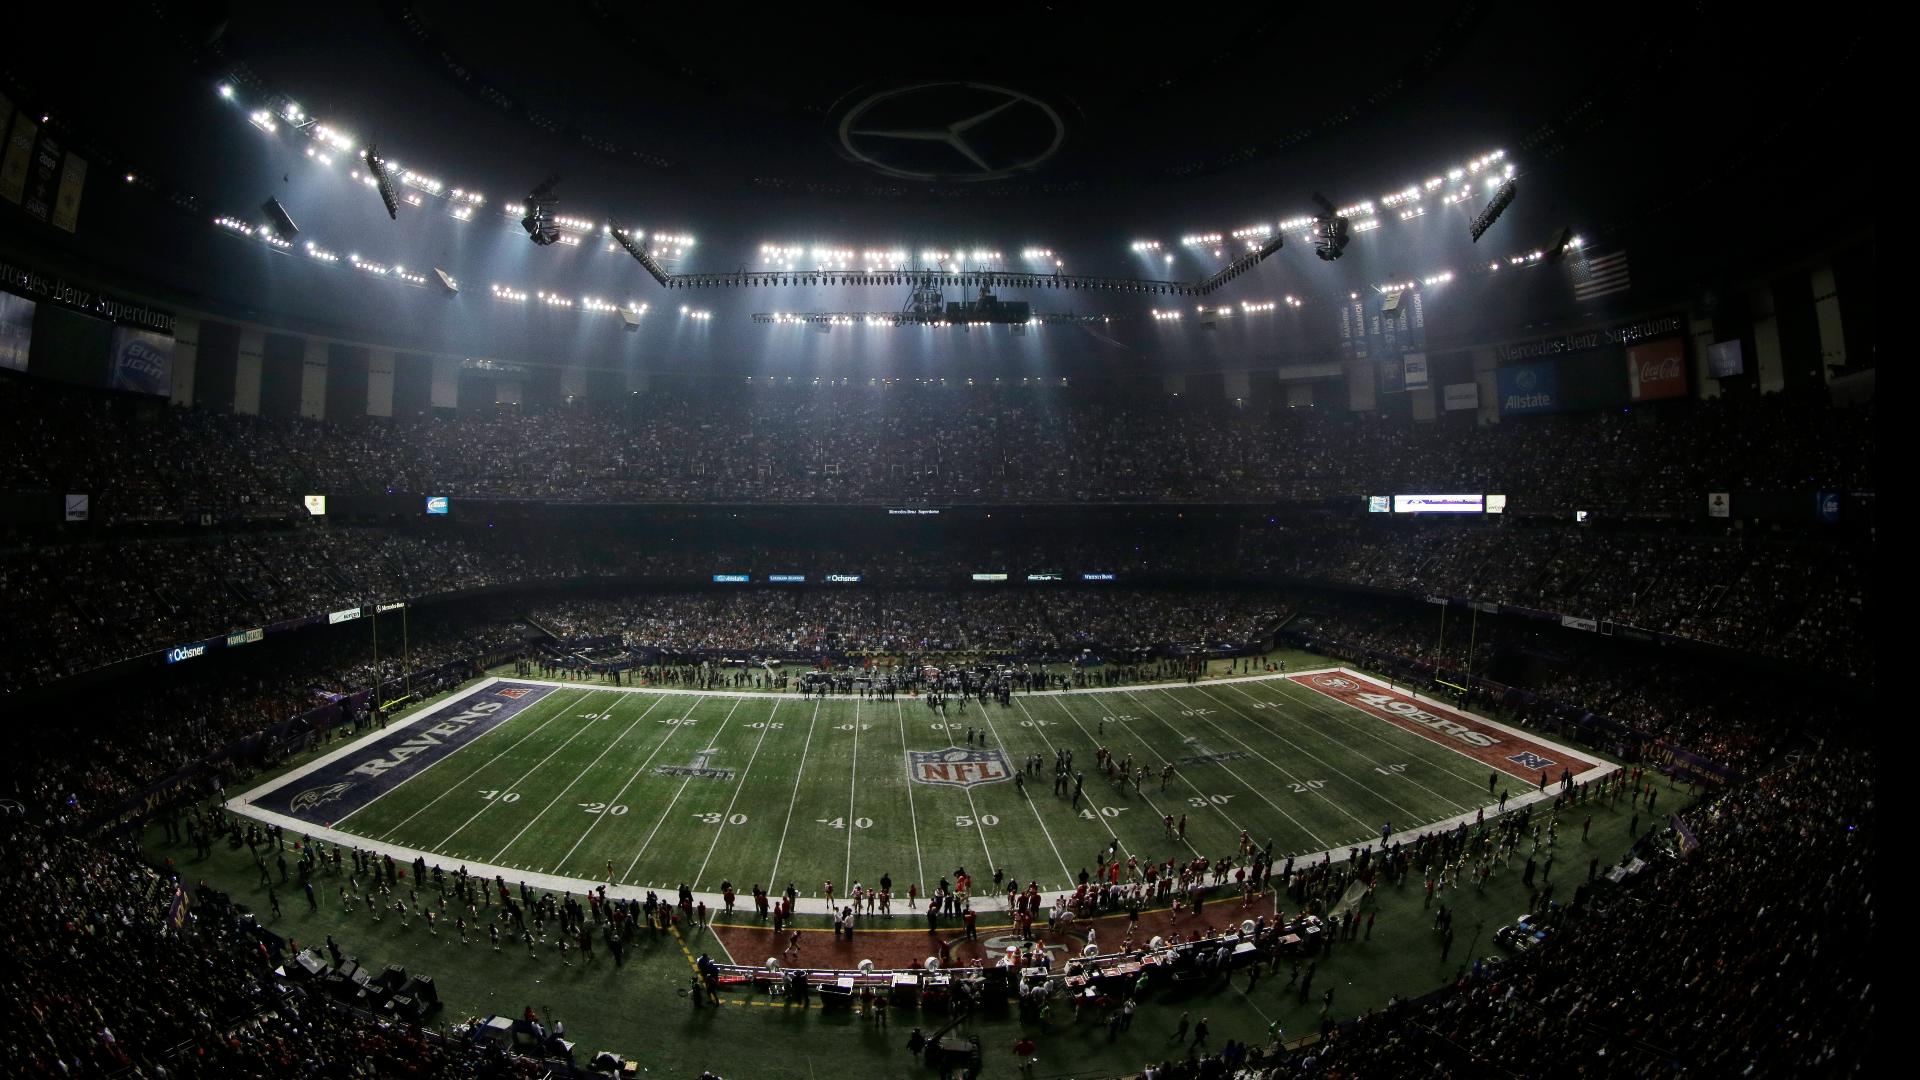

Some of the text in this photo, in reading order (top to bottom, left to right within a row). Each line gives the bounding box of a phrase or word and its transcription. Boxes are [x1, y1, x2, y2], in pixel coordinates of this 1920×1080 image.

[96, 297, 176, 330] Superdome
[1500, 314, 1681, 362] Mercedes-Benz Superdome
[128, 343, 166, 368] BUD
[1505, 393, 1551, 409] Allstate
[831, 574, 858, 582] Ochsner
[174, 645, 204, 662] Ochsner
[1355, 692, 1502, 747] 49ERS
[345, 701, 503, 779] RAVENS
[920, 762, 1003, 782] NFL
[484, 763, 1407, 830] 10 20 30 40 50 40 30 20 10
